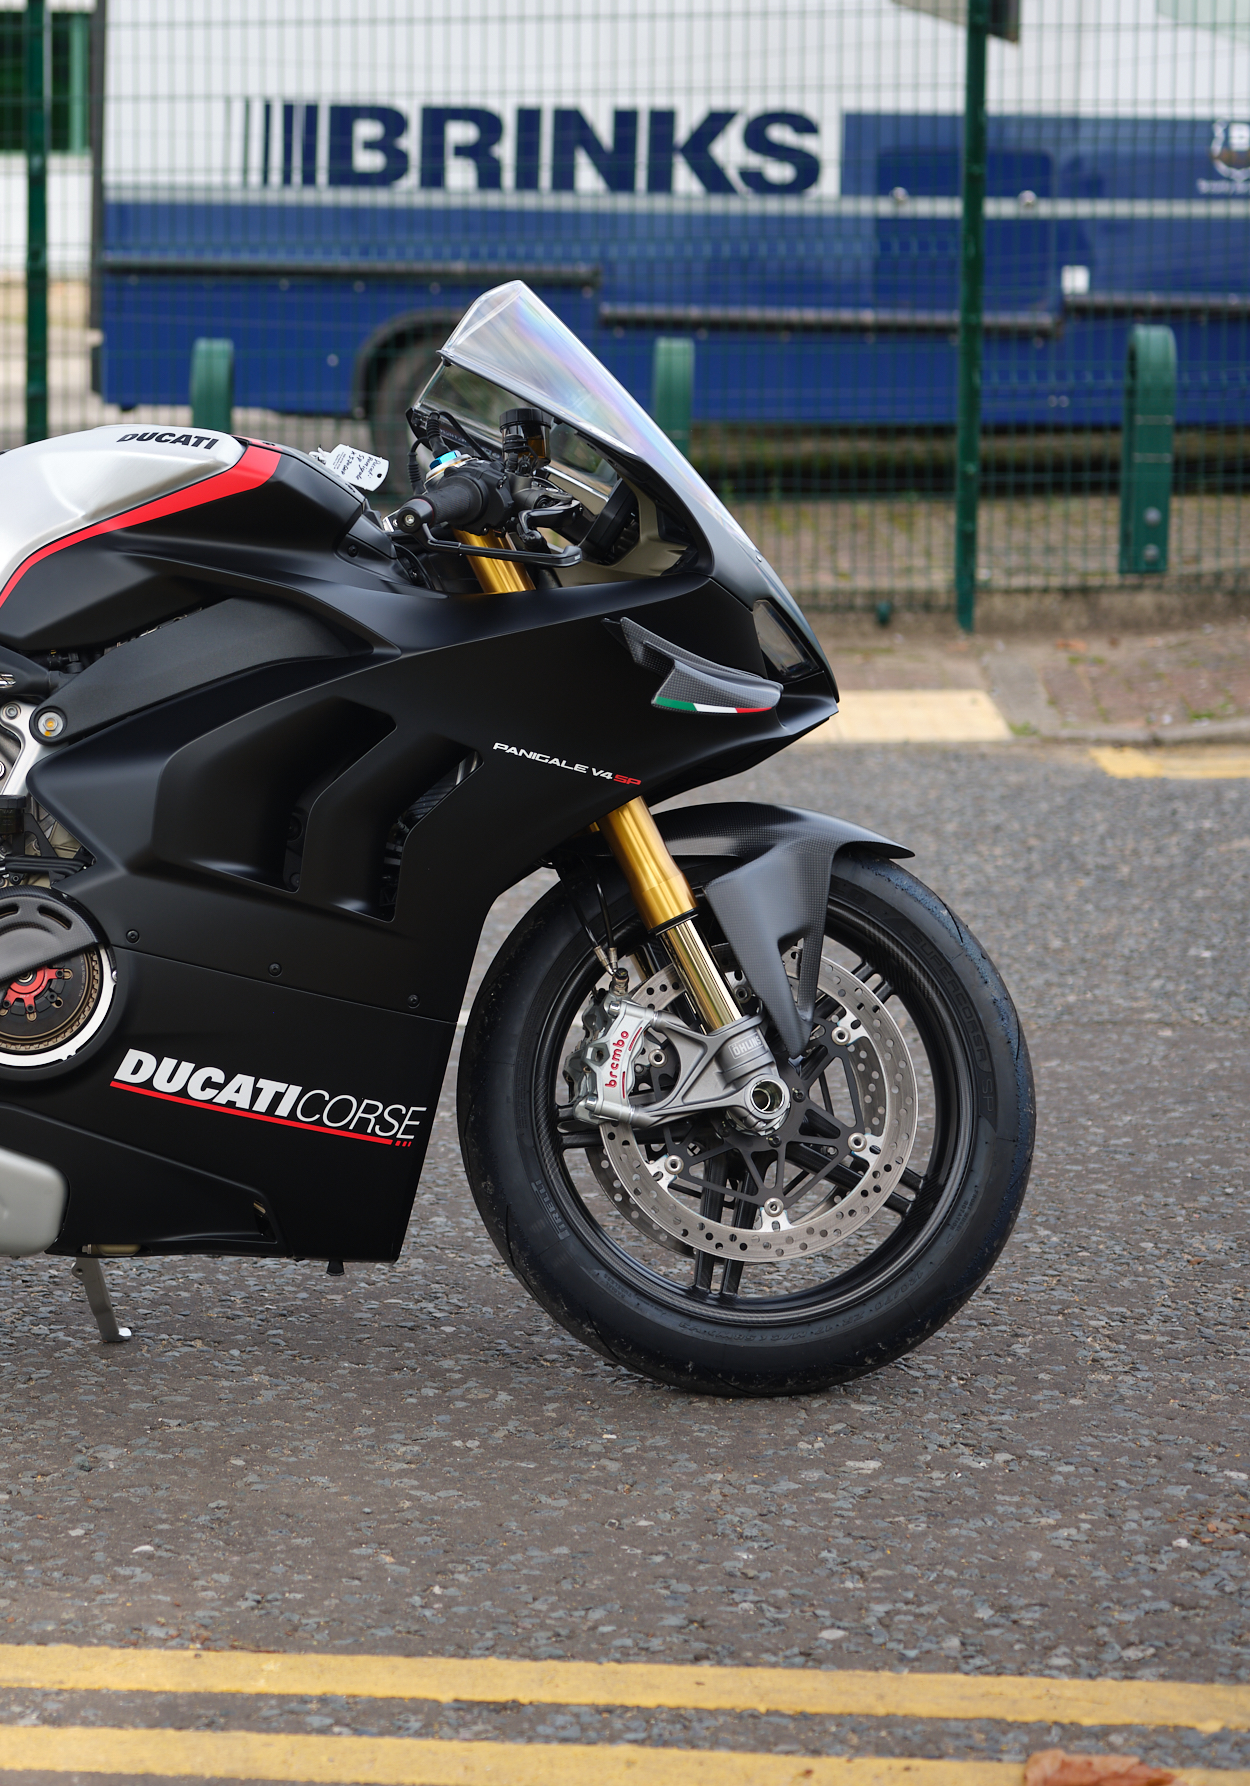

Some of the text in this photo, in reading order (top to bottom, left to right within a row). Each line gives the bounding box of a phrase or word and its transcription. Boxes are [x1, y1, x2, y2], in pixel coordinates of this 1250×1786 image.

[328, 104, 820, 196] BRINKS
[116, 432, 219, 450] DUCATI
[493, 742, 589, 774] PANIGALE
[731, 1035, 762, 1056] ÖHLINS
[907, 930, 993, 1113] SUPERCORSA SP
[605, 1030, 630, 1089] brembo
[529, 1176, 570, 1241] PIRELLI
